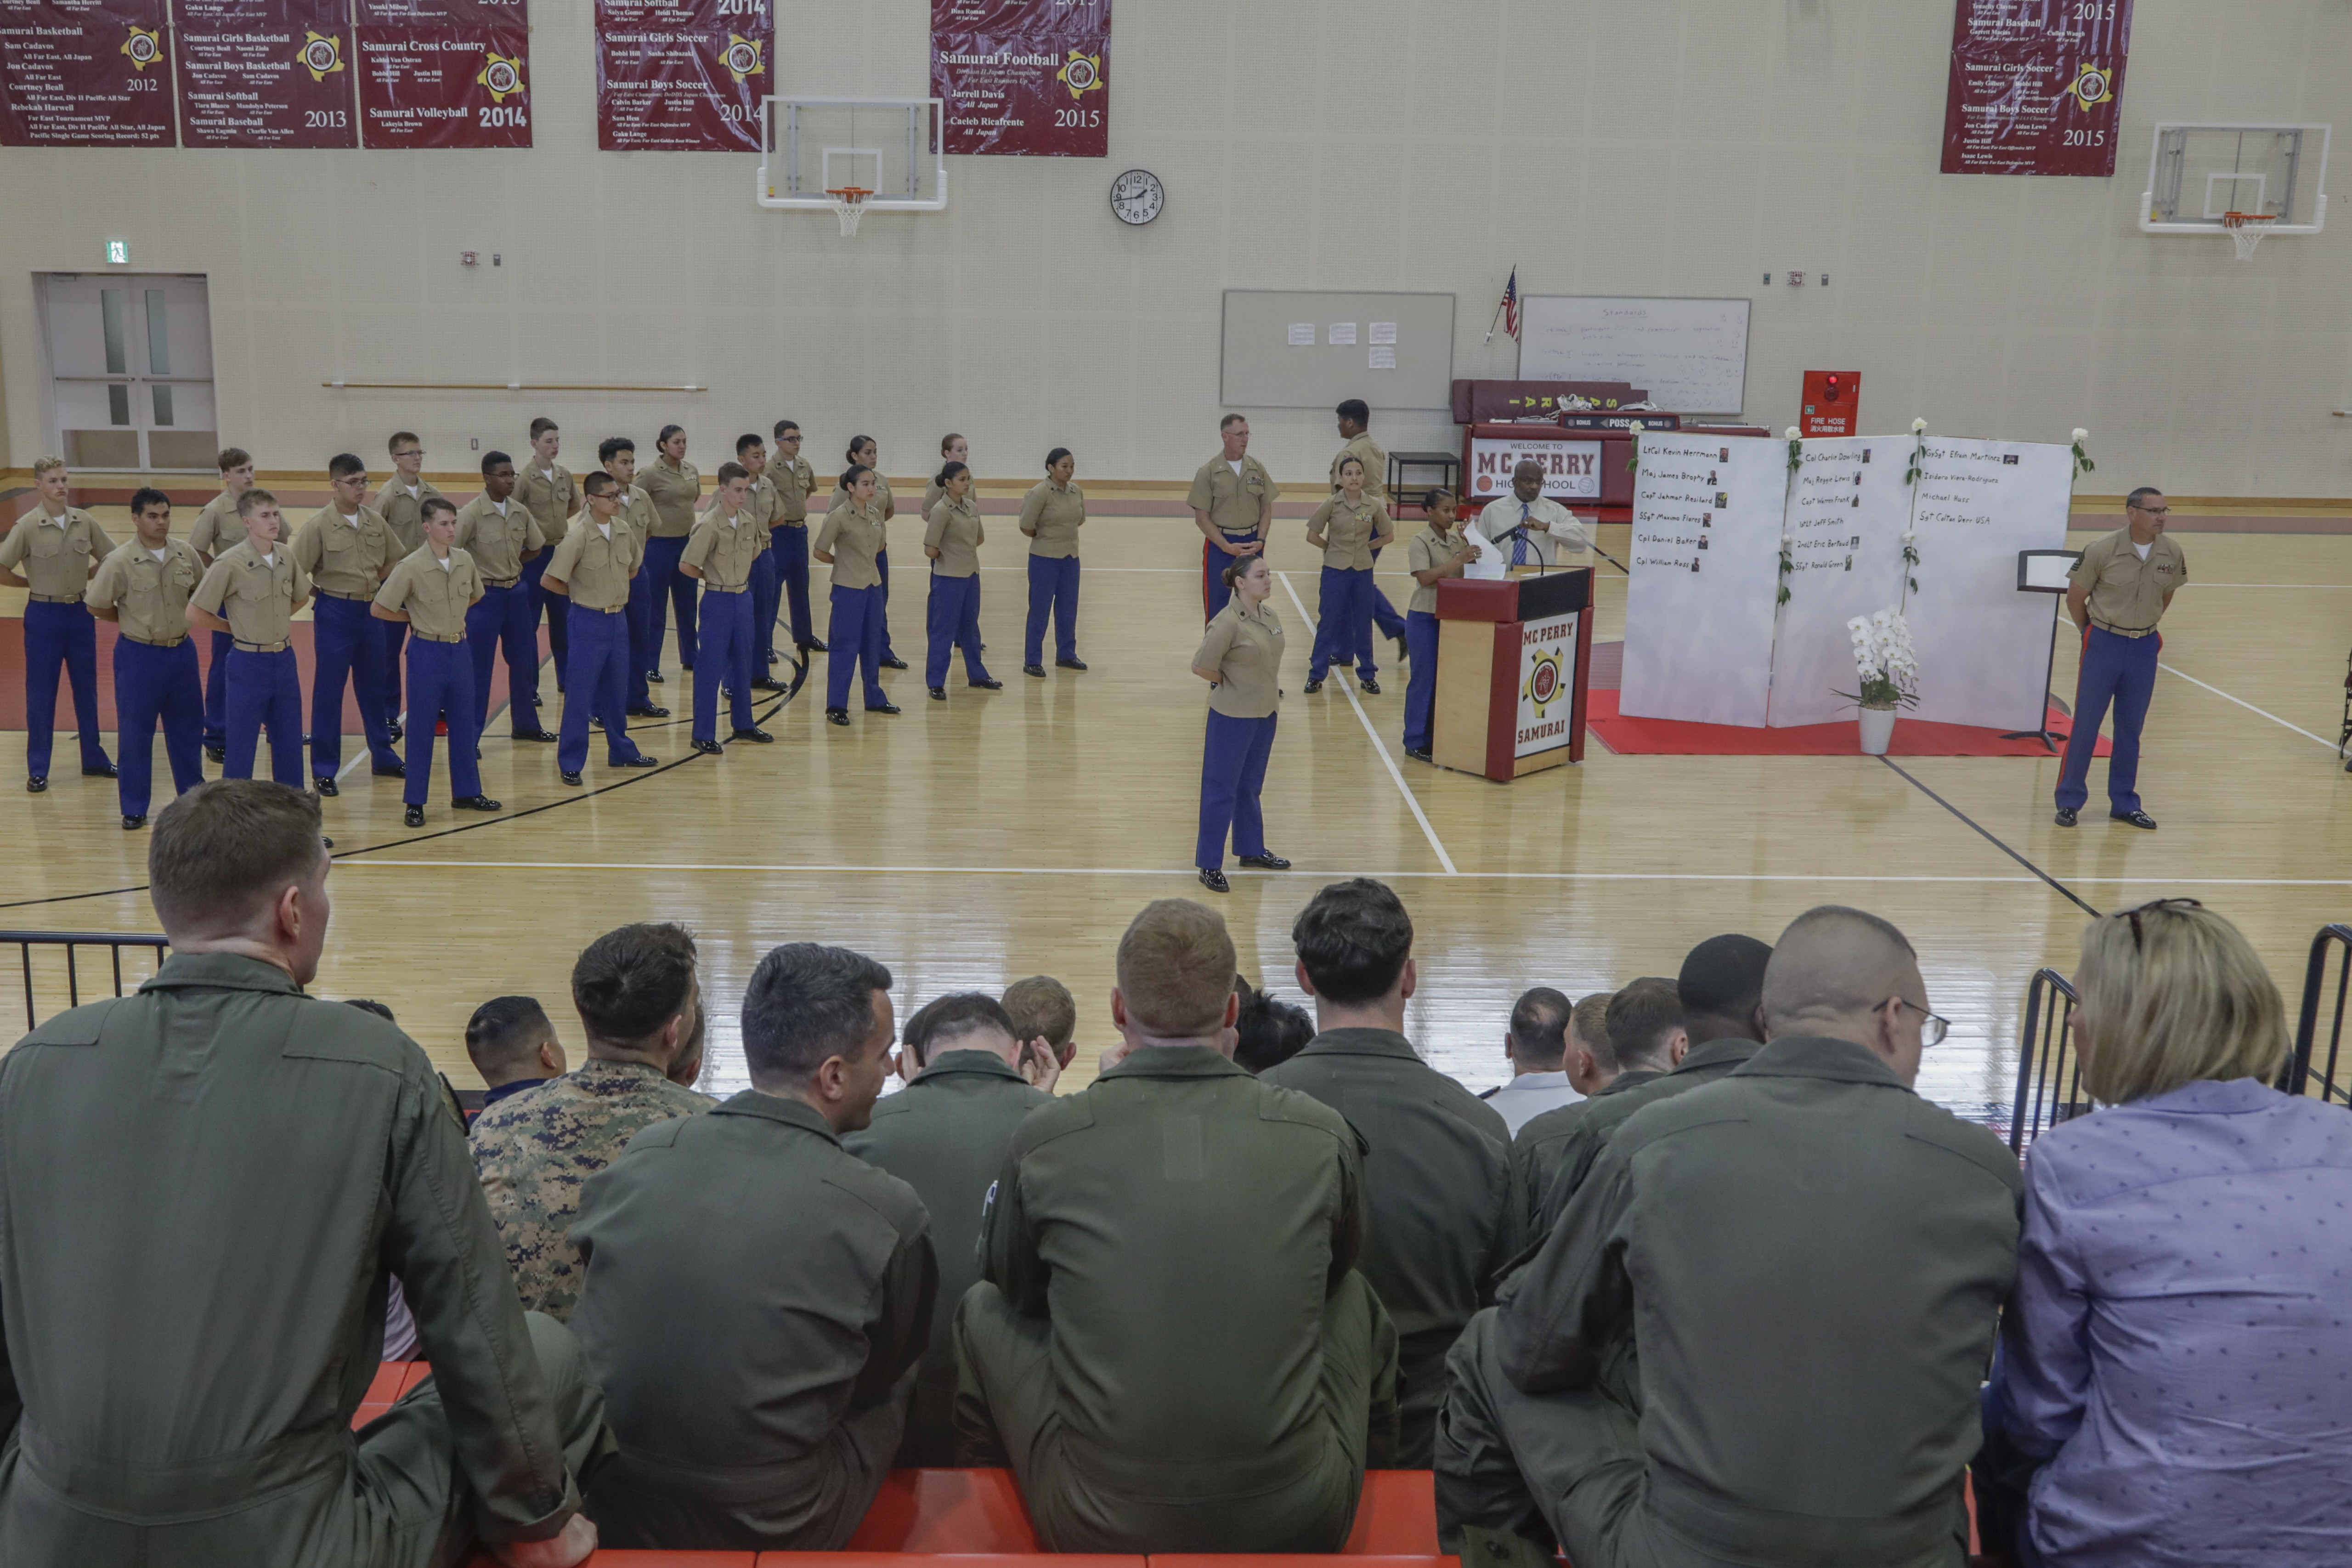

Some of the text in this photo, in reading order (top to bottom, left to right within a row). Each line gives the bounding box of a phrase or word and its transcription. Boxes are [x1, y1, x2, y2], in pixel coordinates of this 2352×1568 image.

[718, 0, 766, 15] 2014
[2073, 3, 2115, 20] 2015
[2006, 19, 2041, 27] Baseball
[36, 27, 83, 35] Basketball
[246, 34, 289, 42] Basketball
[605, 33, 708, 42] Samurai Girls Soccer
[362, 41, 486, 52] Samurai Cross Country
[940, 51, 1059, 66] Samurai Football
[224, 62, 244, 72] Boys
[246, 62, 290, 70] Basketball
[1965, 63, 2054, 73] Samurai Girls Soccer
[127, 79, 158, 91] 2012
[607, 80, 708, 91] Samurai Boys Soccer
[188, 92, 224, 100] Samurai
[370, 108, 468, 119] Samurai Volleyball
[720, 104, 763, 121] 2014
[1962, 104, 2049, 115] Samurai Boys Soccer
[190, 117, 226, 125] Samurai
[305, 111, 346, 128] 2013
[479, 107, 527, 127] 2014
[950, 117, 1024, 126] Caeleb Ricafrente
[1055, 109, 1100, 127] 2015
[2063, 130, 2105, 146] 2015
[1663, 447, 1680, 456] Kevin
[1683, 449, 1717, 459] Herrmann
[1818, 453, 1837, 461] Charlie
[1838, 452, 1860, 461] Dowling
[1926, 449, 2000, 462] GySgt Efrain Martinez
[1477, 451, 1513, 475] MC
[1642, 469, 1705, 482] Maj James Brophy
[1803, 477, 1814, 485] Maj
[1816, 476, 1832, 484] Reggie
[1641, 492, 1713, 504] Capt Jahmar Resilard
[1922, 492, 1970, 503] Michael Huss
[1639, 512, 1655, 521] SSgt
[1827, 517, 1843, 526] Smith
[1919, 511, 1990, 525] Sgt Colton Derr USA
[1638, 534, 1650, 544] Cpl
[1652, 536, 1673, 544] Daniel
[1827, 539, 1849, 548] Bertaud
[1637, 558, 1647, 567] Cpl
[1674, 560, 1689, 568] Ross
[1811, 560, 1827, 569] Ronald
[1523, 622, 1573, 646] MC PERRY
[1518, 719, 1565, 744] SAMURAI
